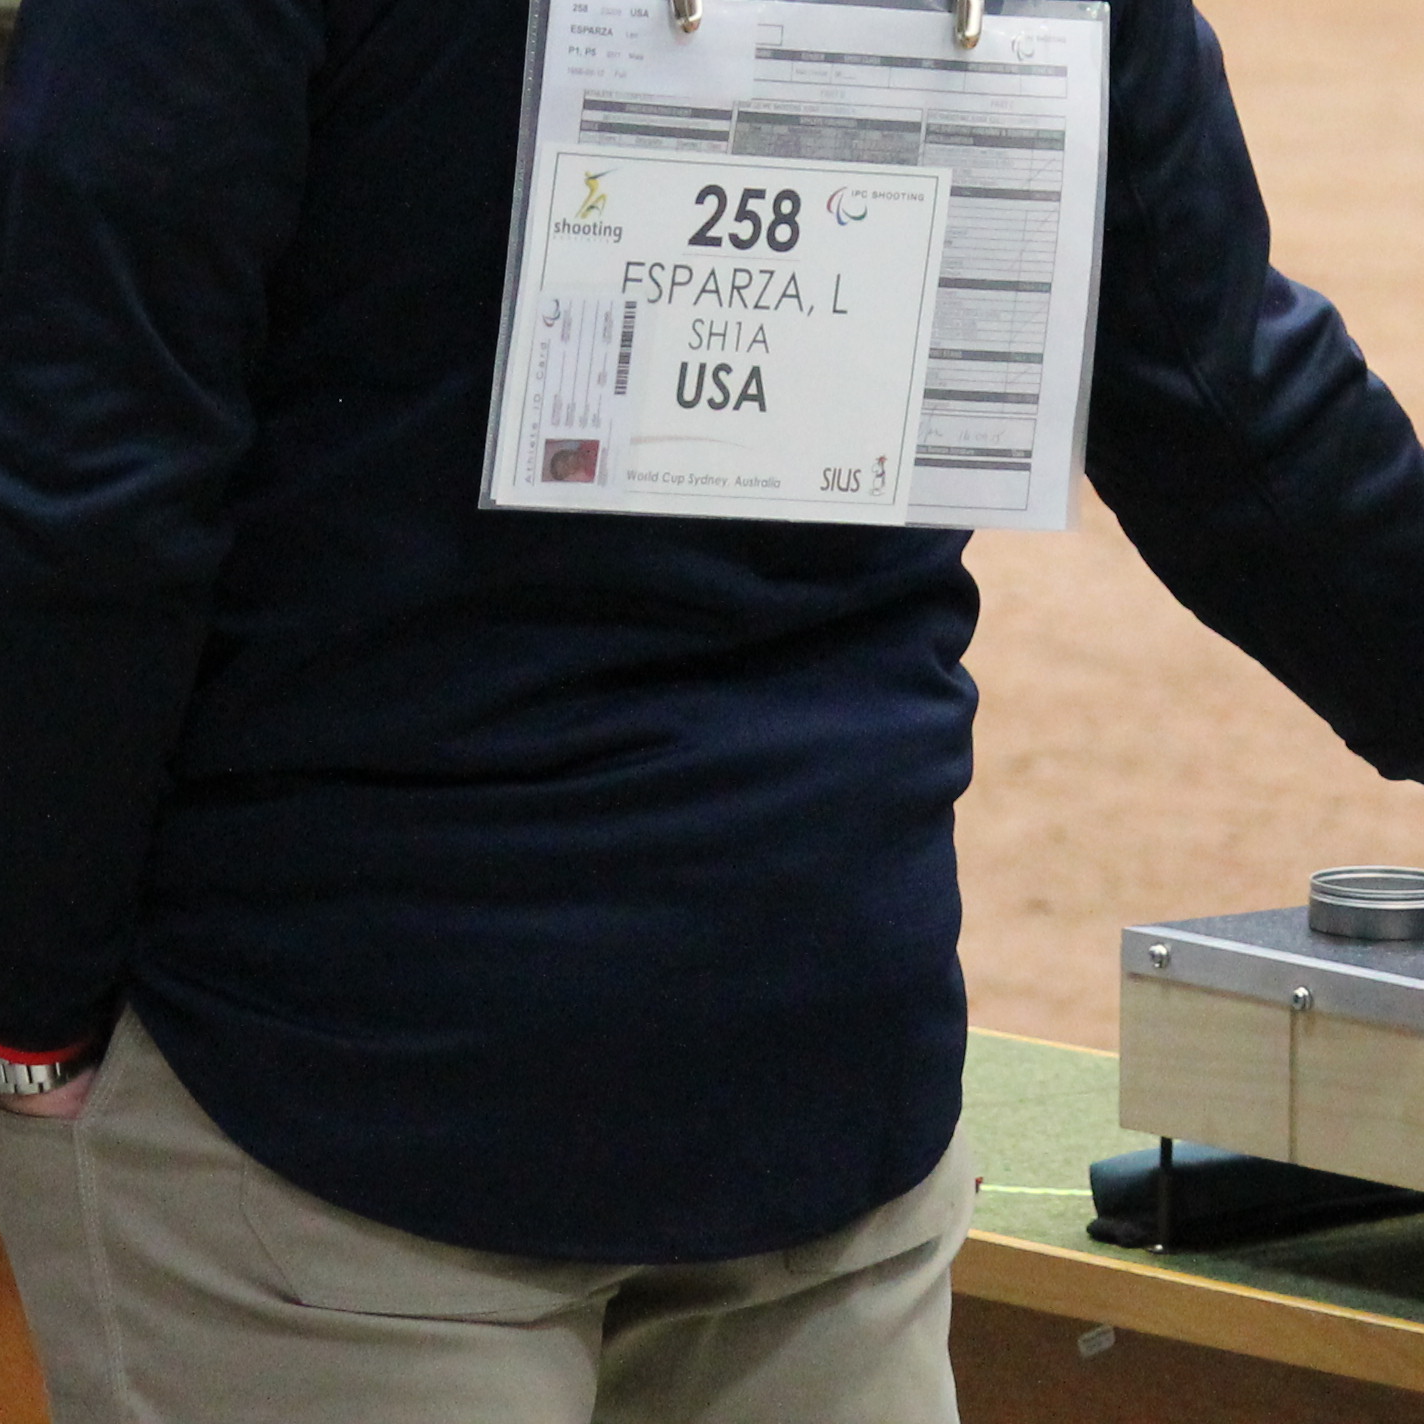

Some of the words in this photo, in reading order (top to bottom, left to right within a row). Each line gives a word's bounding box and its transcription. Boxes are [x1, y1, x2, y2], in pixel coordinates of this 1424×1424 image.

[572, 3, 588, 13] 258
[630, 8, 649, 17] USA
[570, 24, 613, 37] ESPARZA
[850, 189, 868, 200] IPC
[870, 190, 926, 203] SHOOTING
[554, 217, 623, 243] shooting
[687, 184, 802, 253] 258
[832, 274, 848, 314] L
[688, 318, 770, 354] SH1A
[536, 341, 548, 381] Card
[676, 361, 767, 412] USA
[626, 470, 658, 483] World
[661, 472, 685, 486] Cup
[734, 476, 782, 489] Australia
[820, 467, 862, 493] SIUS
